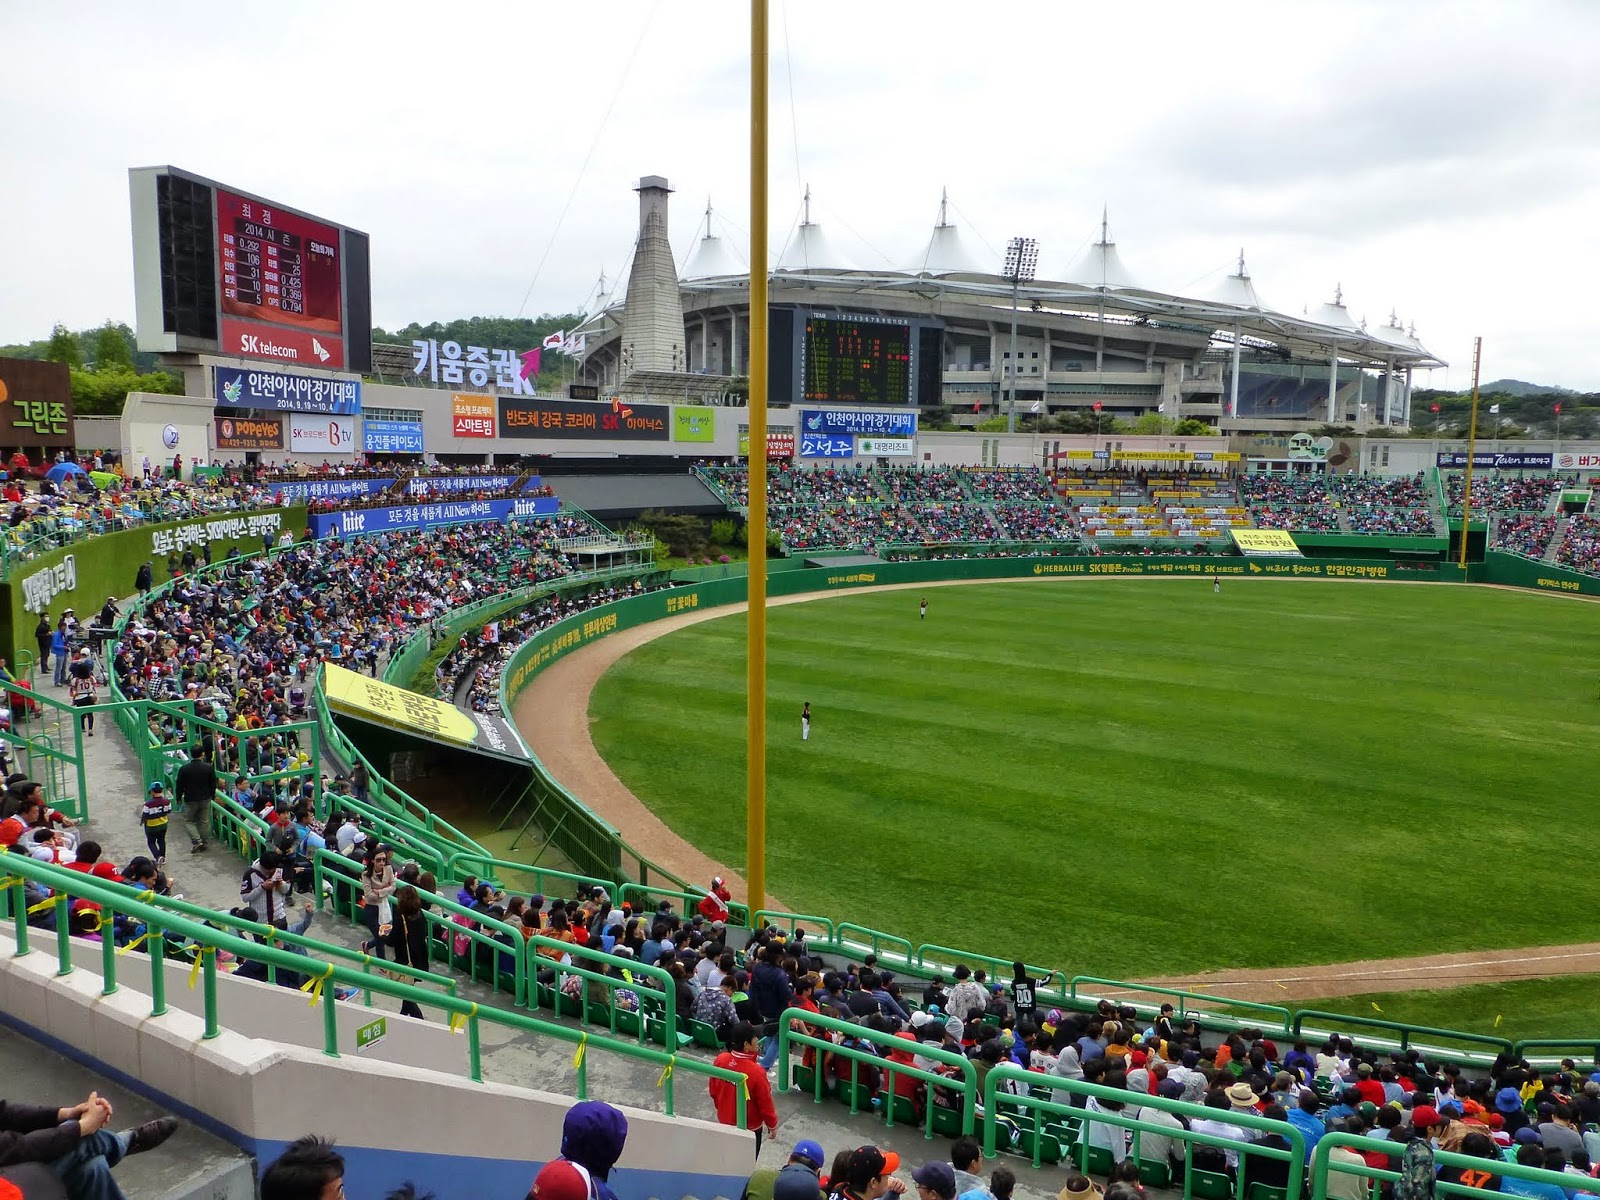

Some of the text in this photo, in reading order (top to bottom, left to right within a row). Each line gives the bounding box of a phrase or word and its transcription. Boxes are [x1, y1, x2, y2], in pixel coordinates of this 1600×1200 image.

[245, 222, 263, 237] 2014
[239, 237, 260, 253] 0.292
[247, 252, 260, 266] 106
[295, 254, 301, 265] 3
[251, 267, 260, 278] 31
[292, 265, 301, 276] 25
[253, 280, 260, 292] 10
[281, 274, 302, 289] 0.425
[256, 294, 262, 305] 5
[281, 286, 302, 301] 0.369
[268, 297, 279, 307] OPS
[282, 302, 303, 313] 0.794
[240, 333, 298, 359] SK telecom
[412, 338, 517, 387] 키움증권
[248, 373, 356, 403] 인천아시아경기대회
[13, 400, 69, 434] 그린존
[455, 406, 471, 416] 초소형
[455, 419, 492, 436] 스마트빔
[506, 409, 664, 431] 반도체 강국 코리아 SK 하이닉스
[826, 412, 911, 428] 인천아시아경기대회
[293, 428, 327, 439] SK 브로드밴드
[329, 421, 352, 447] B tv
[365, 434, 422, 450] 웅진플레이도시
[802, 440, 852, 457] 소성주
[874, 442, 909, 452] 대명리조트
[282, 481, 370, 497] 모든 것을 새롭게 All New 하이트
[409, 479, 428, 495] hite
[440, 479, 452, 489] 것을
[452, 478, 470, 489] 새롭게
[471, 478, 479, 488] All
[479, 478, 492, 488] New
[492, 477, 509, 487] 하이트
[388, 502, 492, 523] 모든 것을 새롭게 All New 하이트
[514, 499, 536, 515] hite
[342, 511, 365, 533] hite
[152, 529, 175, 556] 오늘도
[174, 523, 206, 552] 승리하는
[206, 518, 248, 541] SK와이번스
[1238, 539, 1294, 548] 바로병원
[1043, 564, 1085, 573] HERBALIFE
[1204, 565, 1216, 573] SK
[1326, 564, 1387, 577] 한길안과병원
[398, 689, 449, 732] 바로병원
[1015, 989, 1032, 1004] 00
[362, 1023, 381, 1040] 매점
[1460, 1168, 1492, 1189] 47
